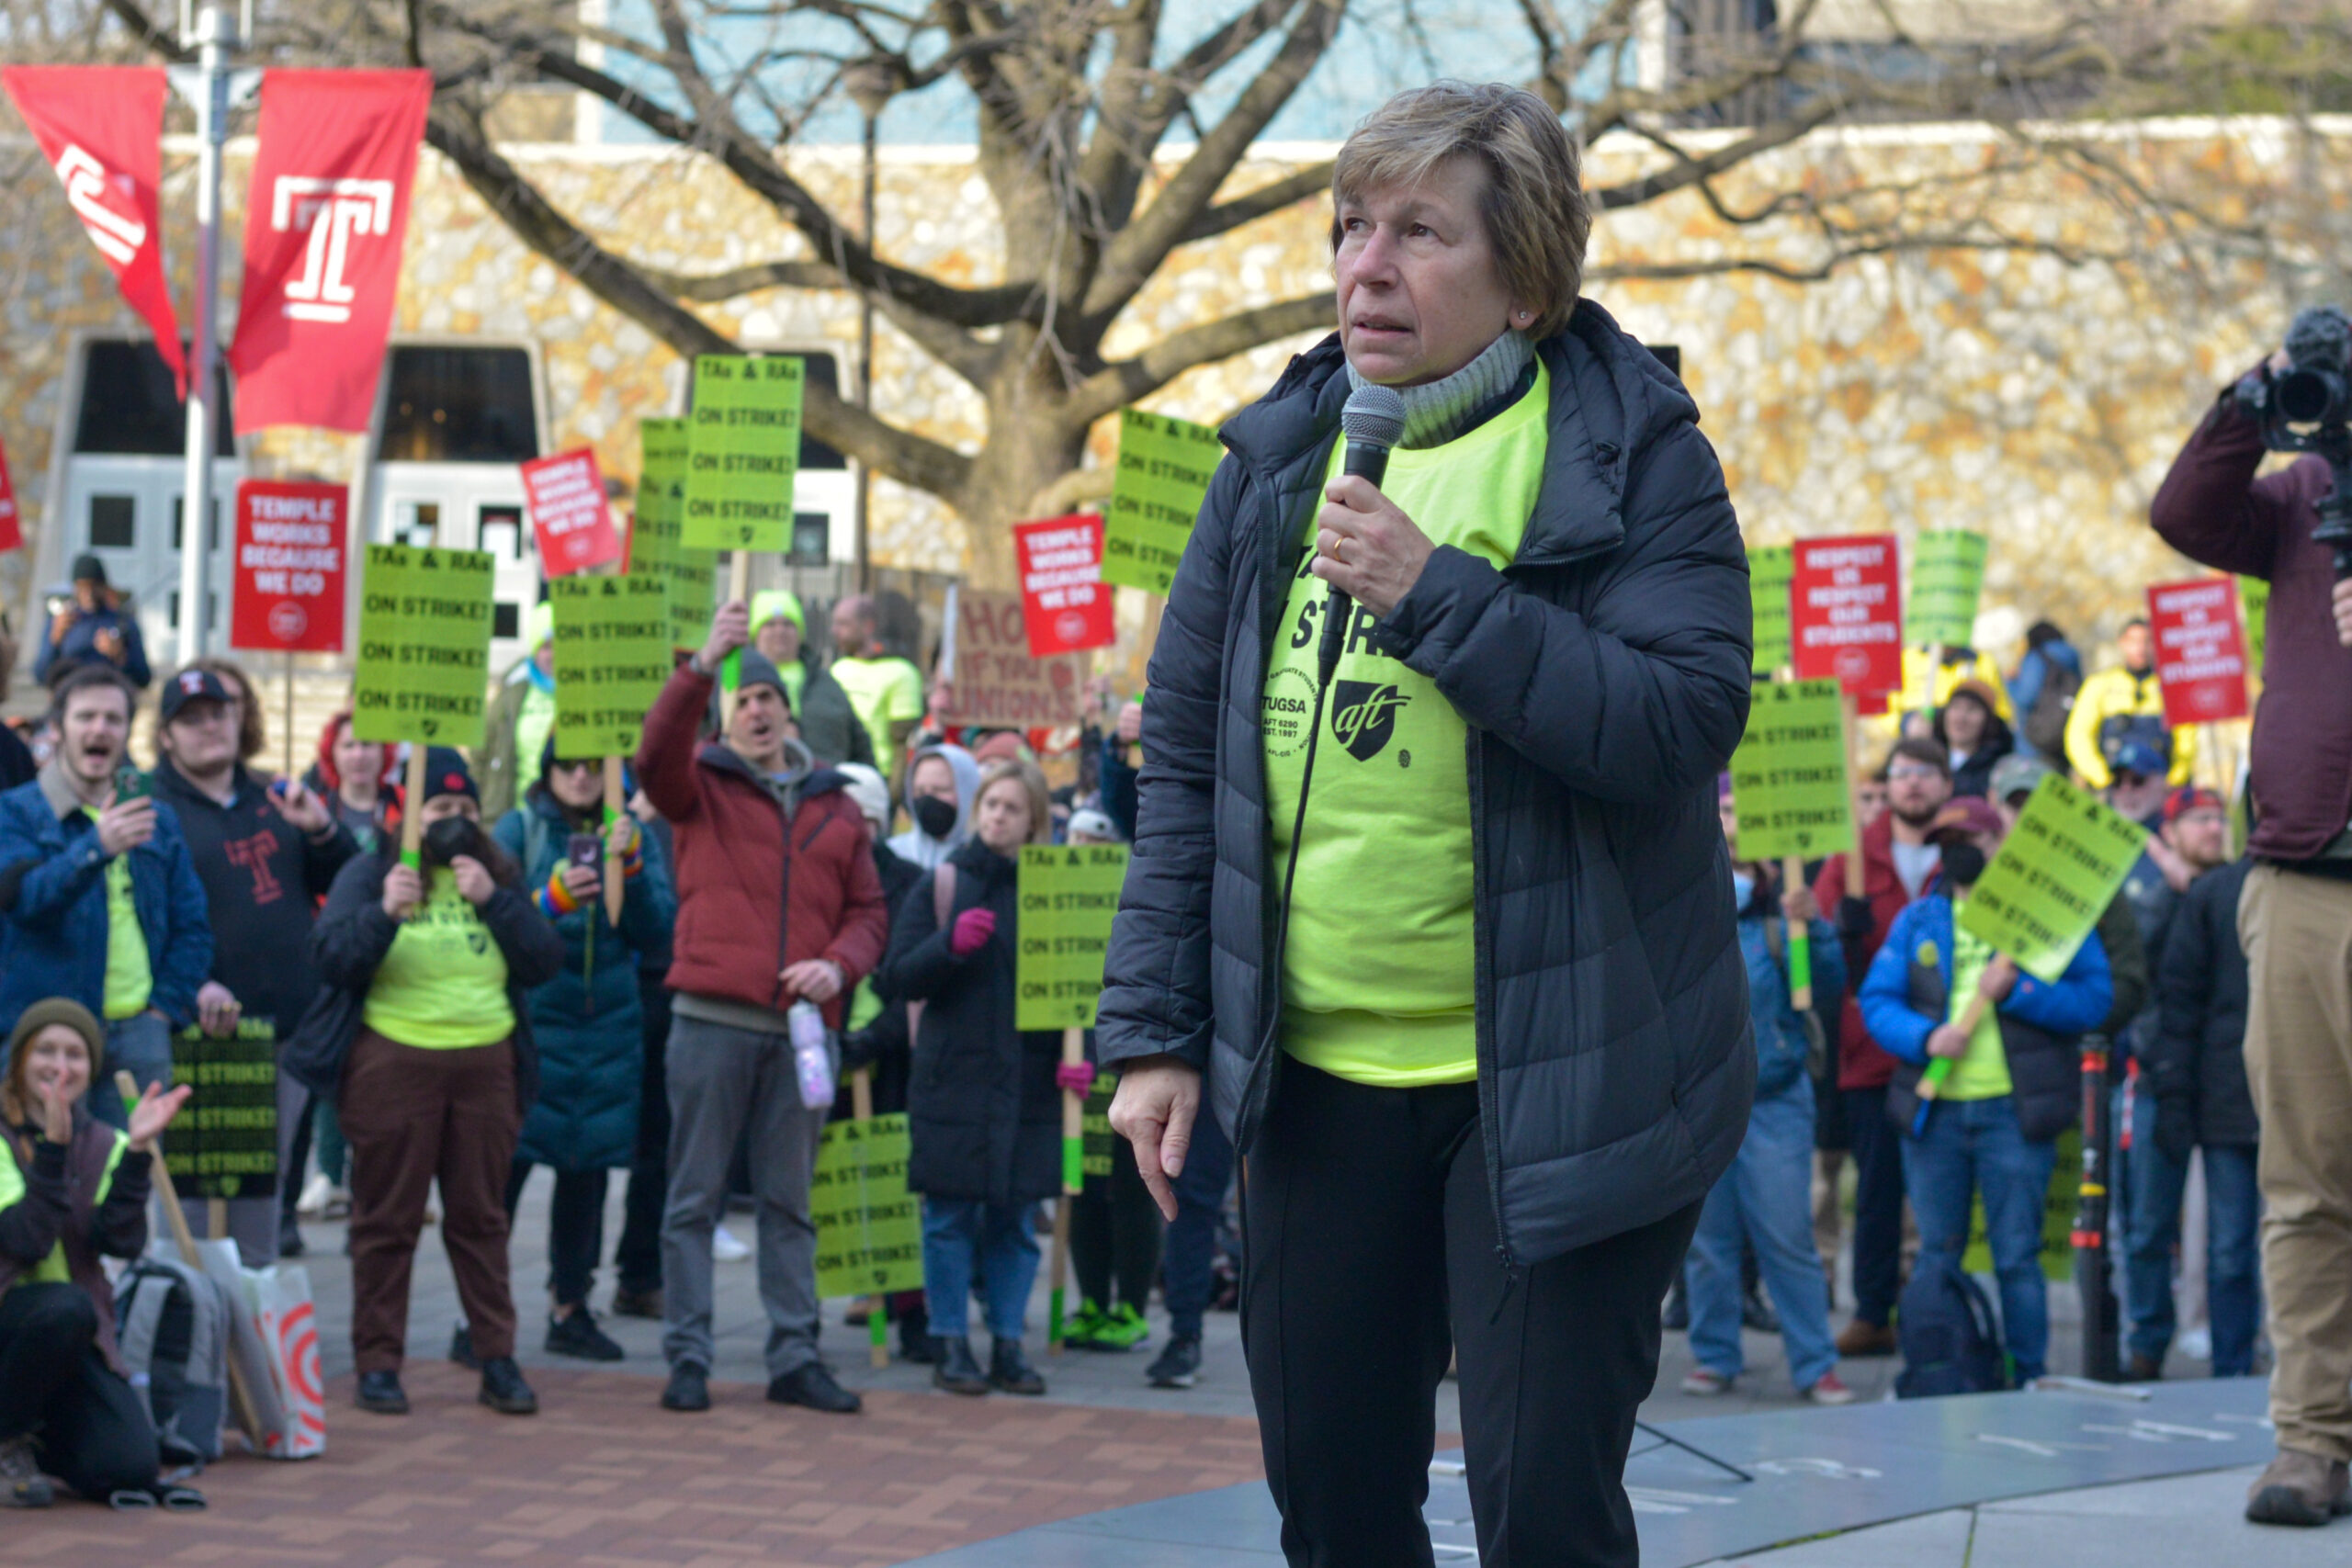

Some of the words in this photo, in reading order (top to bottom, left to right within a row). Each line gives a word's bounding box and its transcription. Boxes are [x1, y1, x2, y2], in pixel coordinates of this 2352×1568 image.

[271, 175, 395, 322] T
[703, 359, 732, 379] TAs
[741, 363, 756, 380] &
[765, 362, 798, 381] RAs
[696, 405, 722, 425] ON
[726, 407, 796, 427] STRIKE!
[692, 453, 718, 470] ON
[723, 453, 792, 475] STRIKE!
[1121, 451, 1145, 471] ON
[248, 495, 335, 521] TEMPLE
[688, 498, 715, 516] ON
[720, 500, 789, 522] STRIKE!
[1115, 493, 1139, 513] ON
[251, 521, 331, 546] WORKS
[1024, 525, 1095, 550] TEMPLE
[241, 544, 338, 570] BECAUSE
[1031, 547, 1095, 570] WORKS
[1108, 537, 1135, 557] ON
[1805, 544, 1884, 569] RESPECT
[371, 547, 407, 567] TAs
[420, 551, 438, 569] &
[449, 552, 490, 571] RAs
[254, 570, 288, 593] WE
[289, 571, 325, 595] DO
[1024, 563, 1102, 592] BECAUSE
[1832, 568, 1861, 585] US
[1038, 588, 1065, 610] WE
[1067, 584, 1096, 605] DO
[1807, 582, 1887, 607] RESPECT
[366, 593, 396, 614] ON
[403, 597, 488, 620] STRIKE!
[1828, 605, 1870, 625] OUR
[556, 624, 583, 639] ON
[1803, 621, 1897, 648] STUDENTS
[362, 642, 392, 662] ON
[401, 645, 486, 669] STRIKE!
[557, 667, 585, 682] ON
[359, 689, 390, 710] ON
[396, 693, 481, 716] STRIKE!
[1262, 695, 1306, 714] TUGSA
[559, 711, 586, 727] ON
[593, 708, 646, 726] STRIK
[1263, 717, 1278, 727] AFT
[1278, 719, 1298, 728] 6290
[1335, 683, 1412, 749] aft
[1278, 729, 1298, 739] 1997
[1736, 772, 1763, 790] ON
[1738, 812, 1767, 831] ON
[2022, 815, 2048, 840] ON
[1024, 849, 1056, 866] TAs
[1066, 848, 1081, 866] &
[1089, 848, 1124, 865] RAs
[1999, 852, 2025, 874] ON
[1023, 893, 1049, 911] ON
[1053, 892, 1119, 910] STRIKE
[1975, 887, 2003, 911] ON
[1023, 937, 1049, 955] ON
[1053, 936, 1105, 954] STRIK
[1022, 981, 1049, 1000] ON
[1052, 980, 1104, 998] STRIK
[198, 1061, 276, 1084] STRIKE!
[198, 1105, 277, 1129] STRIKE!
[198, 1150, 277, 1174] STRIKE!
[815, 1253, 842, 1272] ON
